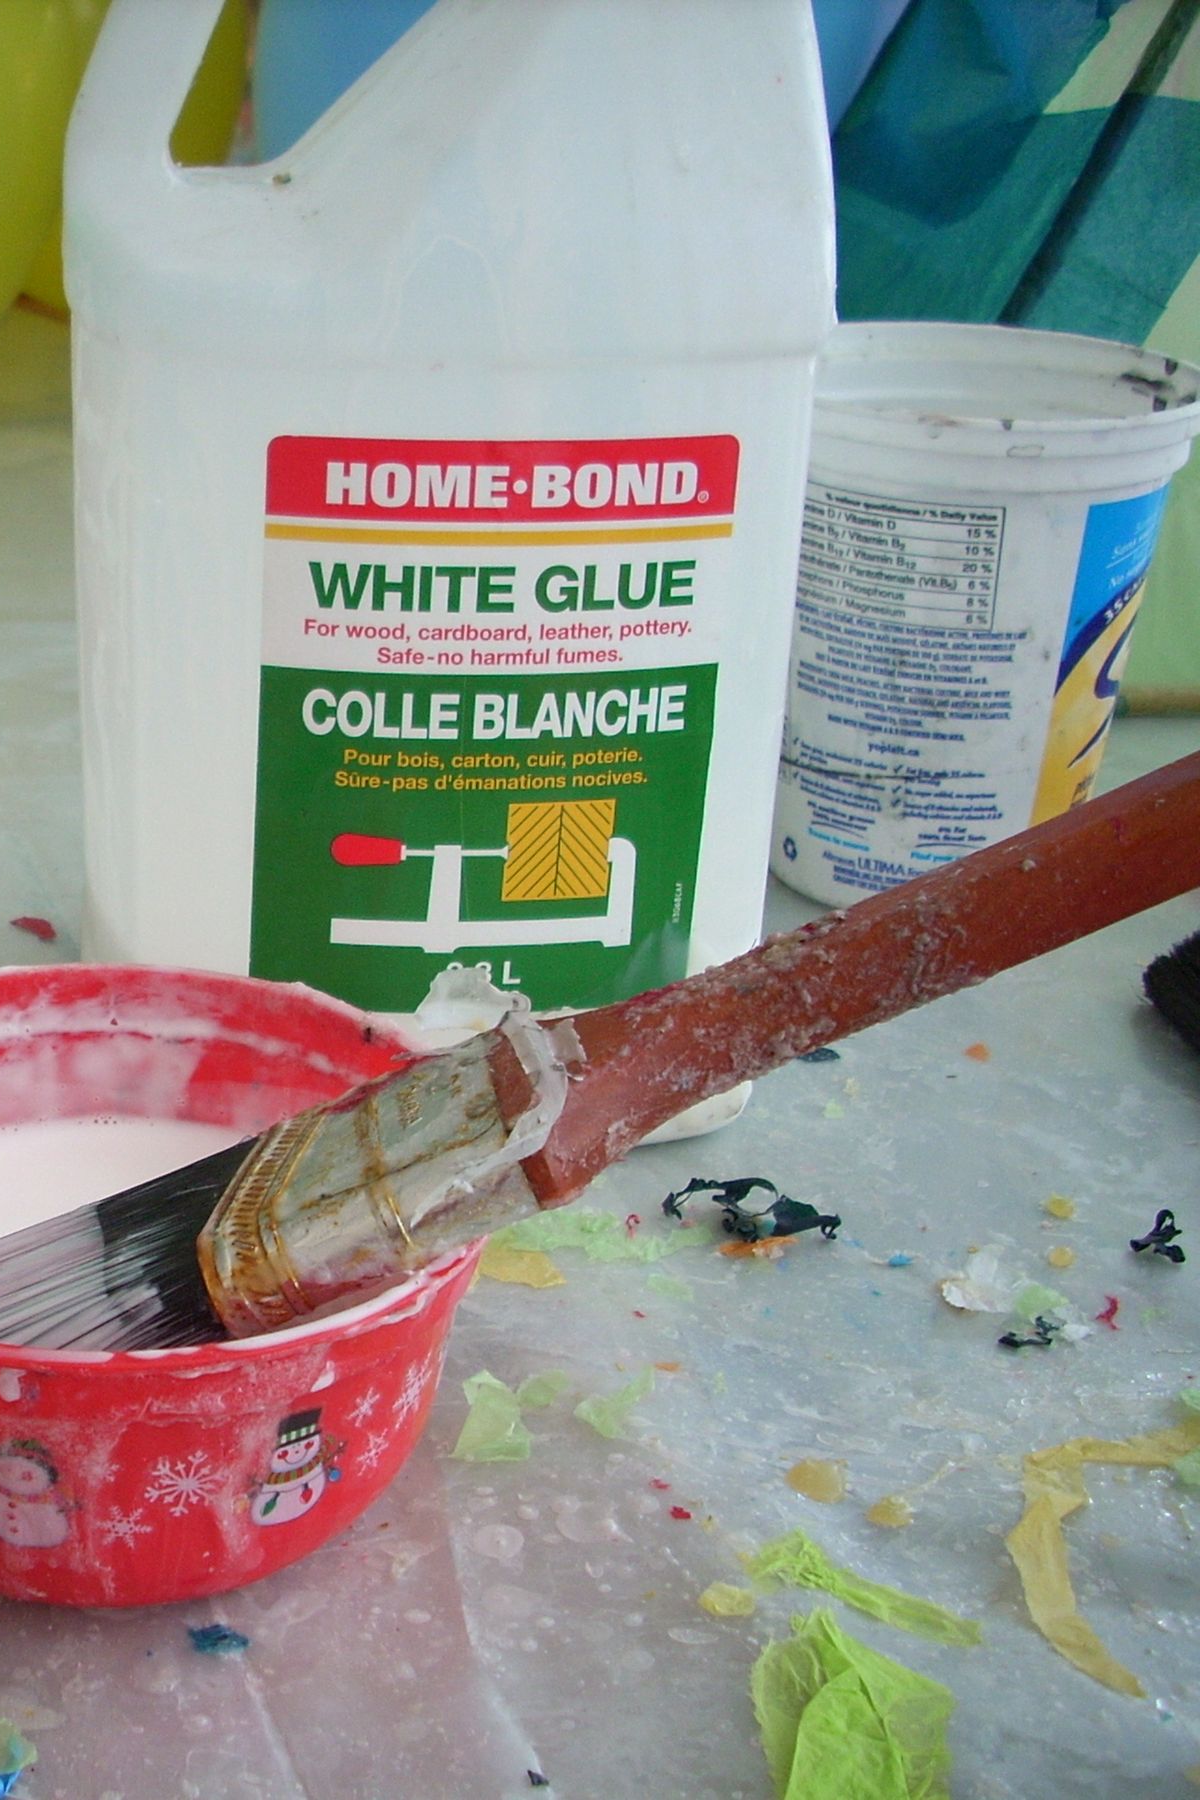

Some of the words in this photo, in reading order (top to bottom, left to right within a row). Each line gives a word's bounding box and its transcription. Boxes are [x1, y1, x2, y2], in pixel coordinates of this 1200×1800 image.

[827, 508, 836, 519] D
[844, 513, 884, 529] Vitamin
[887, 520, 896, 530] D
[967, 529, 982, 539] 15
[984, 530, 996, 539] %
[940, 510, 966, 521] Daily
[970, 513, 998, 521] Value
[849, 531, 889, 547] Vitamin
[965, 546, 980, 556] 10
[983, 547, 995, 556] %
[853, 549, 893, 565] Vitamin
[962, 564, 978, 573] 20
[981, 564, 993, 574] %
[308, 561, 516, 613] WHITE
[535, 560, 696, 613] GLUE
[849, 566, 915, 585] Pantothenate
[979, 581, 990, 591] %
[842, 582, 905, 601] Phosphorus
[977, 598, 988, 607] %
[846, 599, 906, 618] Magnesium
[976, 616, 988, 625] %
[303, 619, 338, 638] For
[346, 622, 411, 643] wood,
[418, 622, 532, 644] cardboard,
[539, 622, 613, 642] leather,
[619, 619, 692, 640] pottery.
[470, 648, 550, 666] harmful
[557, 647, 623, 665] fumes.
[302, 688, 460, 739] COLLE
[473, 685, 687, 740] BLANCHE
[343, 749, 391, 766] Pour
[397, 750, 445, 770] bois,
[451, 752, 520, 770] carton,
[527, 749, 566, 769] cuir,
[572, 748, 643, 767] poterie.
[435, 773, 566, 791] d'émanations
[572, 769, 648, 787] nocives.
[858, 857, 905, 876] ULTIMA
[503, 961, 521, 985] L
